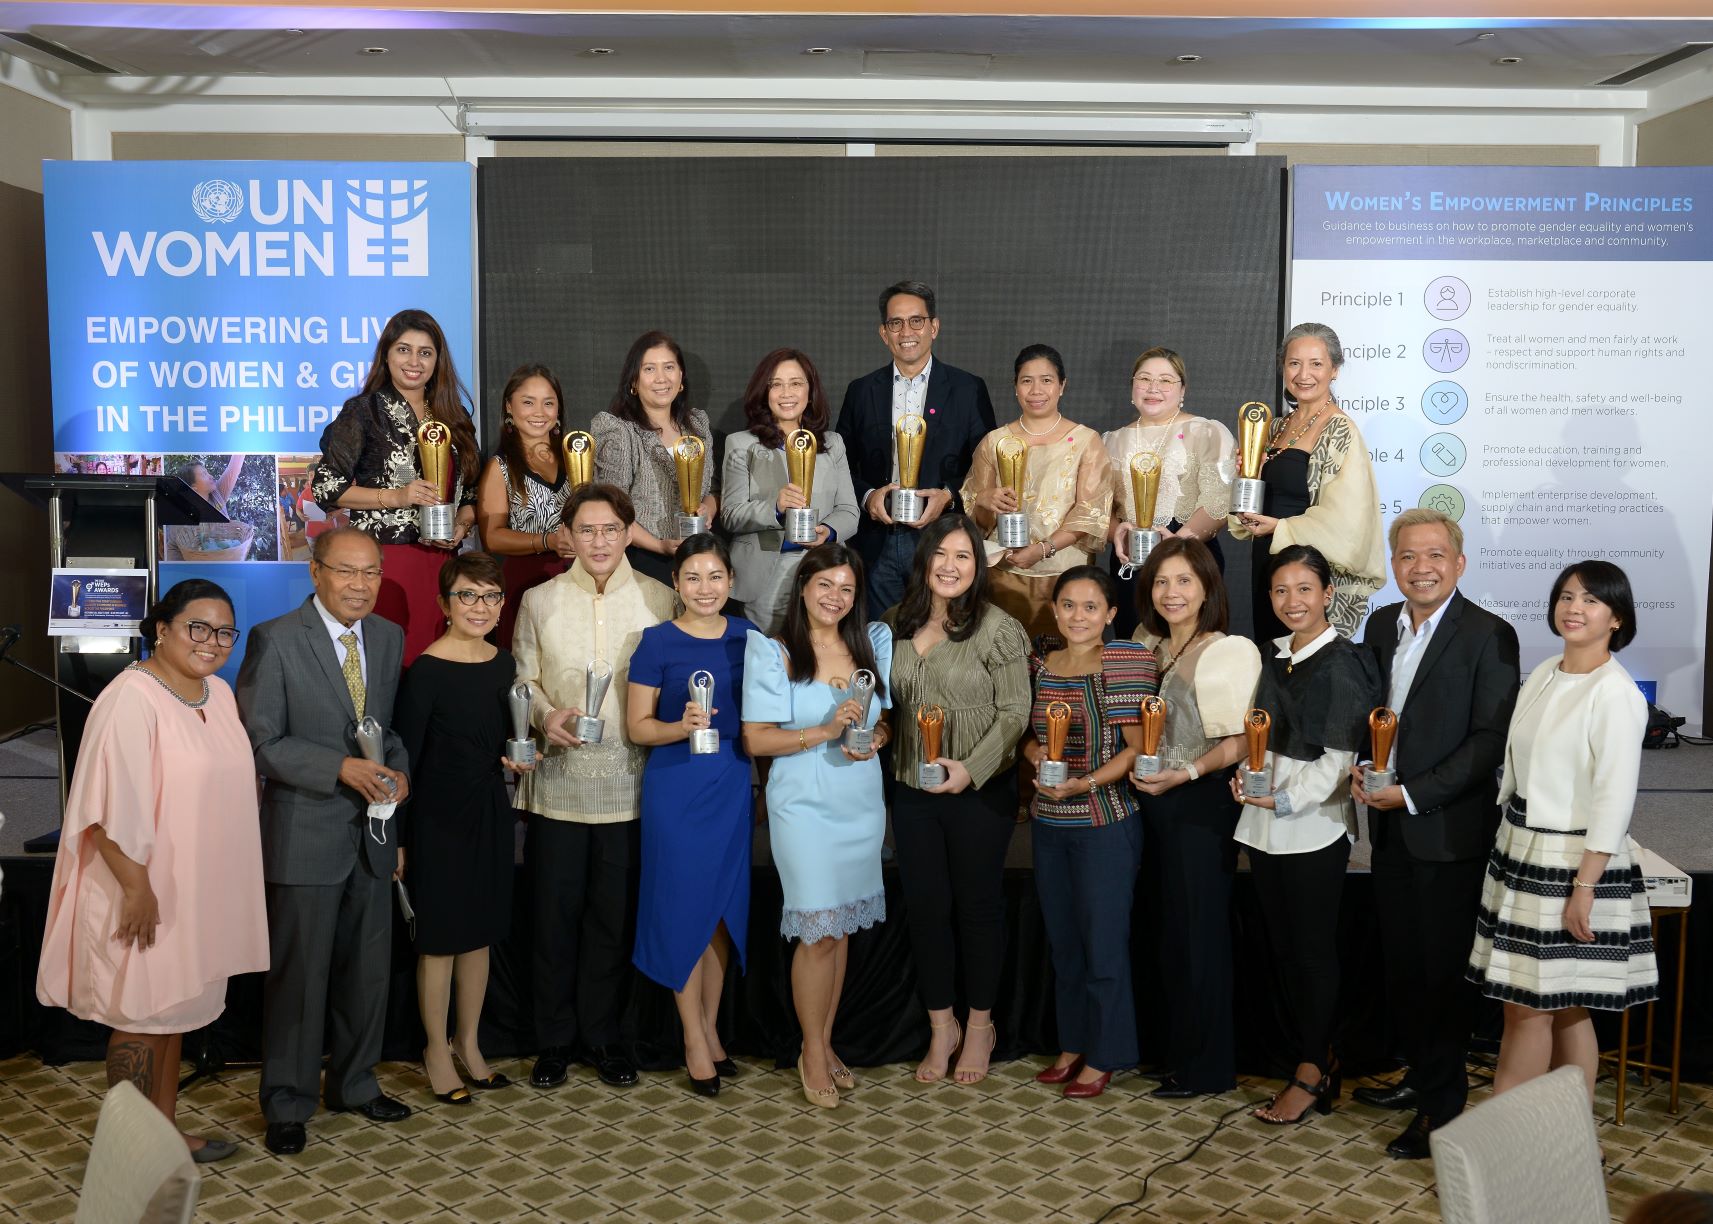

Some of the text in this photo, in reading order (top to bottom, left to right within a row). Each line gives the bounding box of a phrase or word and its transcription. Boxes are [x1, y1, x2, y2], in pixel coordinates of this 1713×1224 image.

[250, 180, 333, 224] UN
[1430, 191, 1577, 211] EMPOWERMENT
[1584, 192, 1692, 212] PRINCIPLES
[1322, 220, 1372, 231] Guidance
[1375, 221, 1385, 231] to
[1388, 220, 1434, 230] business
[1452, 220, 1474, 231] how
[1477, 222, 1488, 231] to
[1491, 221, 1536, 232] promote
[1538, 221, 1576, 233] gender
[1579, 221, 1621, 233] equality
[1624, 223, 1644, 232] and
[1647, 221, 1693, 232] women's
[1346, 235, 1422, 246] empowerment
[1426, 235, 1434, 244] in
[1438, 234, 1454, 245] the
[1457, 235, 1514, 246] workplace,
[1517, 235, 1582, 246] marketplace
[1584, 235, 1604, 246] and
[92, 231, 334, 276] WOMEN
[1322, 292, 1403, 308] Principle 1
[1488, 288, 1635, 300] Establish high-level corporate
[1487, 301, 1539, 312] leadership
[1542, 301, 1556, 311] for
[1558, 302, 1594, 312] gender
[86, 316, 392, 344] EMPOWERING LIV
[1487, 333, 1512, 343] Treat
[1514, 333, 1525, 344] all
[1567, 334, 1586, 344] and
[1613, 334, 1638, 346] fairly
[1640, 335, 1650, 344] at
[1653, 335, 1679, 344] work
[1342, 344, 1406, 360] nciple 2
[1494, 347, 1532, 358] respect
[1534, 347, 1553, 357] and
[1556, 347, 1595, 358] support
[1597, 347, 1631, 357] human
[1634, 348, 1663, 359] rights
[1665, 347, 1684, 356] and
[92, 360, 138, 388] OF
[149, 360, 284, 388] WOMEN
[296, 361, 319, 388] &
[1485, 392, 1518, 402] Ensure
[1521, 392, 1537, 402] the
[1575, 393, 1606, 404] safety
[1608, 392, 1627, 403] and
[1630, 393, 1682, 404] well-being
[1337, 396, 1404, 413] inciple 3
[1484, 405, 1494, 414] of
[1496, 405, 1507, 415] all
[1510, 407, 1547, 415] women
[1549, 406, 1568, 415] and
[96, 406, 343, 432] IN THE PHILIP
[1394, 448, 1404, 462] 4
[1483, 444, 1525, 454] Promote
[1582, 445, 1620, 455] training
[1623, 445, 1641, 455] and
[1482, 457, 1542, 468] professional
[1545, 458, 1610, 469] development
[1613, 458, 1627, 468] for
[1482, 490, 1534, 500] Implement
[1537, 490, 1587, 500] enterprise
[1393, 500, 1402, 514] 5
[1481, 502, 1664, 514] supply chain and marketing practices
[1481, 515, 1500, 524] that
[1503, 517, 1549, 526] empower
[1480, 547, 1664, 559] Promote equality through community
[1479, 560, 1525, 570] initiatives
[1528, 560, 1546, 570] and
[1478, 599, 1519, 608] Measure
[1521, 599, 1540, 607] and
